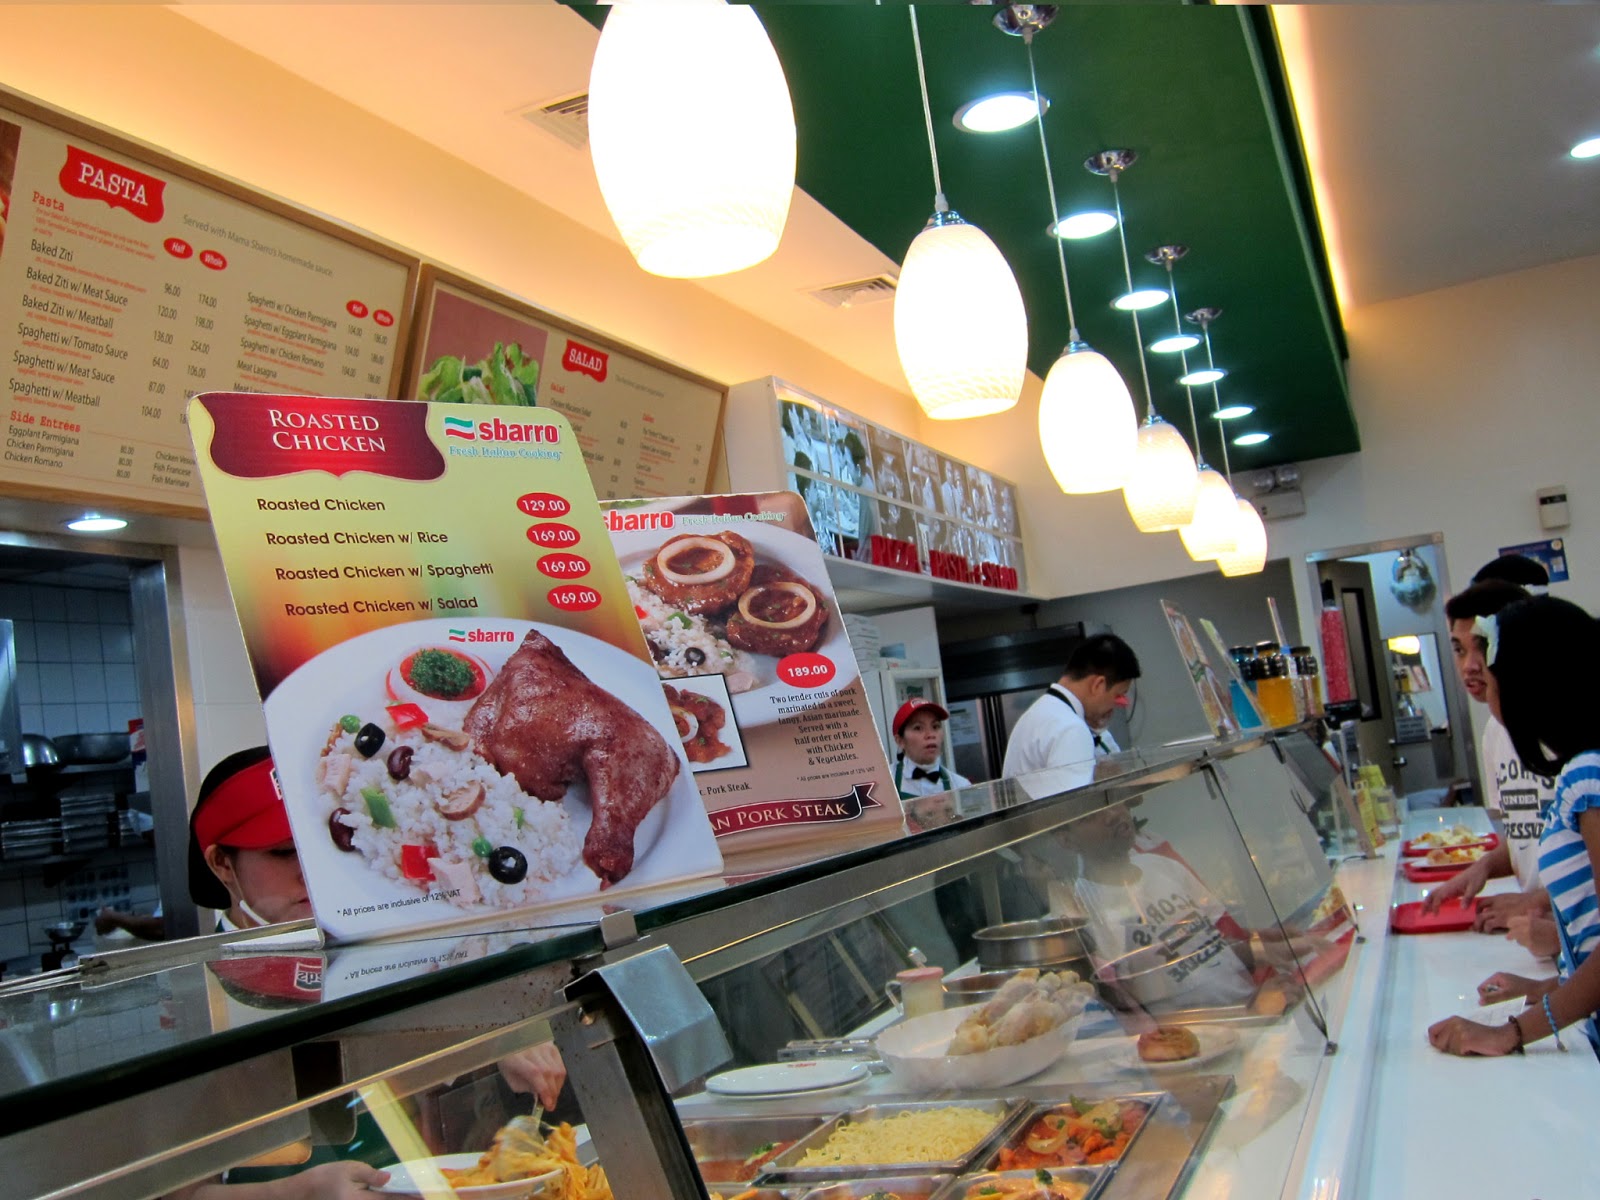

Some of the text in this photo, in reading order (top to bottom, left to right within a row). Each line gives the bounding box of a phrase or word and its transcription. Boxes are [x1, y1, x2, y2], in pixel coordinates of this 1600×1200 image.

[78, 161, 148, 206] PASTA
[32, 191, 64, 212] Pasta
[31, 238, 58, 257] Baked
[58, 247, 74, 262] Ziti
[183, 214, 209, 232] Served
[210, 225, 227, 240] with
[228, 231, 250, 247] Mama
[278, 249, 314, 271] homemade
[171, 240, 187, 255] Half
[204, 252, 223, 268] Whole
[26, 266, 53, 285] Baked
[54, 274, 69, 289] Ziti
[70, 281, 82, 292] w/
[82, 283, 104, 299] Meat
[104, 289, 129, 306] Sauce
[164, 282, 181, 298] 96.00
[199, 293, 218, 309] 174.00
[22, 294, 49, 312] Baked
[49, 301, 65, 316] Ziti
[66, 308, 78, 319] w/
[78, 310, 114, 329] Meatball
[158, 304, 177, 320] 120.00
[247, 291, 276, 309] Spaghetti
[284, 303, 307, 319] Chicken
[307, 311, 337, 329] Parmigiana
[244, 314, 273, 331] Spaghetti
[307, 334, 337, 351] Parmigiana
[17, 322, 60, 345] Spaghetti
[61, 335, 73, 347] w/
[73, 336, 104, 354] Tomato
[104, 343, 129, 361] Sauce
[190, 339, 210, 355] 254.00
[240, 336, 269, 354] Spaghetti
[278, 347, 301, 362] Chicken
[301, 354, 325, 369] Romano
[568, 348, 603, 372] SALAD
[13, 349, 56, 370] Spaghetti
[56, 362, 69, 373] w/
[69, 363, 90, 378] Meat
[91, 367, 116, 384] Sauce
[152, 355, 170, 370] 64.00
[236, 359, 253, 372] Meat
[253, 365, 277, 380] Lasagna
[187, 364, 207, 379] 106.00
[8, 377, 51, 396] Spaghetti
[51, 389, 64, 399] w/
[64, 389, 101, 407] Meatball
[148, 380, 166, 395] 87.00
[10, 410, 35, 424] Side
[141, 404, 161, 420] 104.00
[268, 409, 379, 431] ROASTED
[8, 424, 80, 446] Eggplant Parmigiana
[478, 417, 559, 443] sbarro
[6, 438, 74, 458] Chicken Parmigiana
[272, 431, 386, 452] CHICKEN
[4, 451, 63, 468] Chicken Romano
[155, 450, 179, 463] Chicken
[449, 445, 561, 461] Fresh Italian Cooking
[153, 462, 166, 472] Fish
[151, 474, 164, 483] Fish
[257, 498, 386, 511] Roasted Chicken
[522, 499, 566, 512] 129.00
[682, 511, 786, 526] Fresh Italian Cooking
[266, 531, 449, 545] Roasted Chicken w/ Rice
[532, 530, 576, 542] 169.00
[275, 562, 494, 580] Roasted Chicken w/ Spaghetti
[542, 560, 587, 573] 169.00
[552, 591, 597, 604] 169.00
[285, 596, 479, 616] Roasted Chicken w/ Salad
[468, 628, 515, 642] sbarro
[787, 664, 828, 678] 189.00
[769, 687, 857, 704] Two tender cuts of pork
[778, 703, 818, 714] marinated
[802, 712, 824, 722] Asian
[798, 724, 825, 734] Served
[825, 721, 842, 730] with
[794, 730, 858, 745] half order of Rice
[806, 742, 854, 754] with Chicken
[808, 758, 815, 766] &
[706, 782, 752, 795] Pork Steak.
[1502, 794, 1538, 806] UNDER
[737, 803, 849, 826] PORK STEAK
[342, 889, 461, 917] All prices are inclusive of 12% VAT
